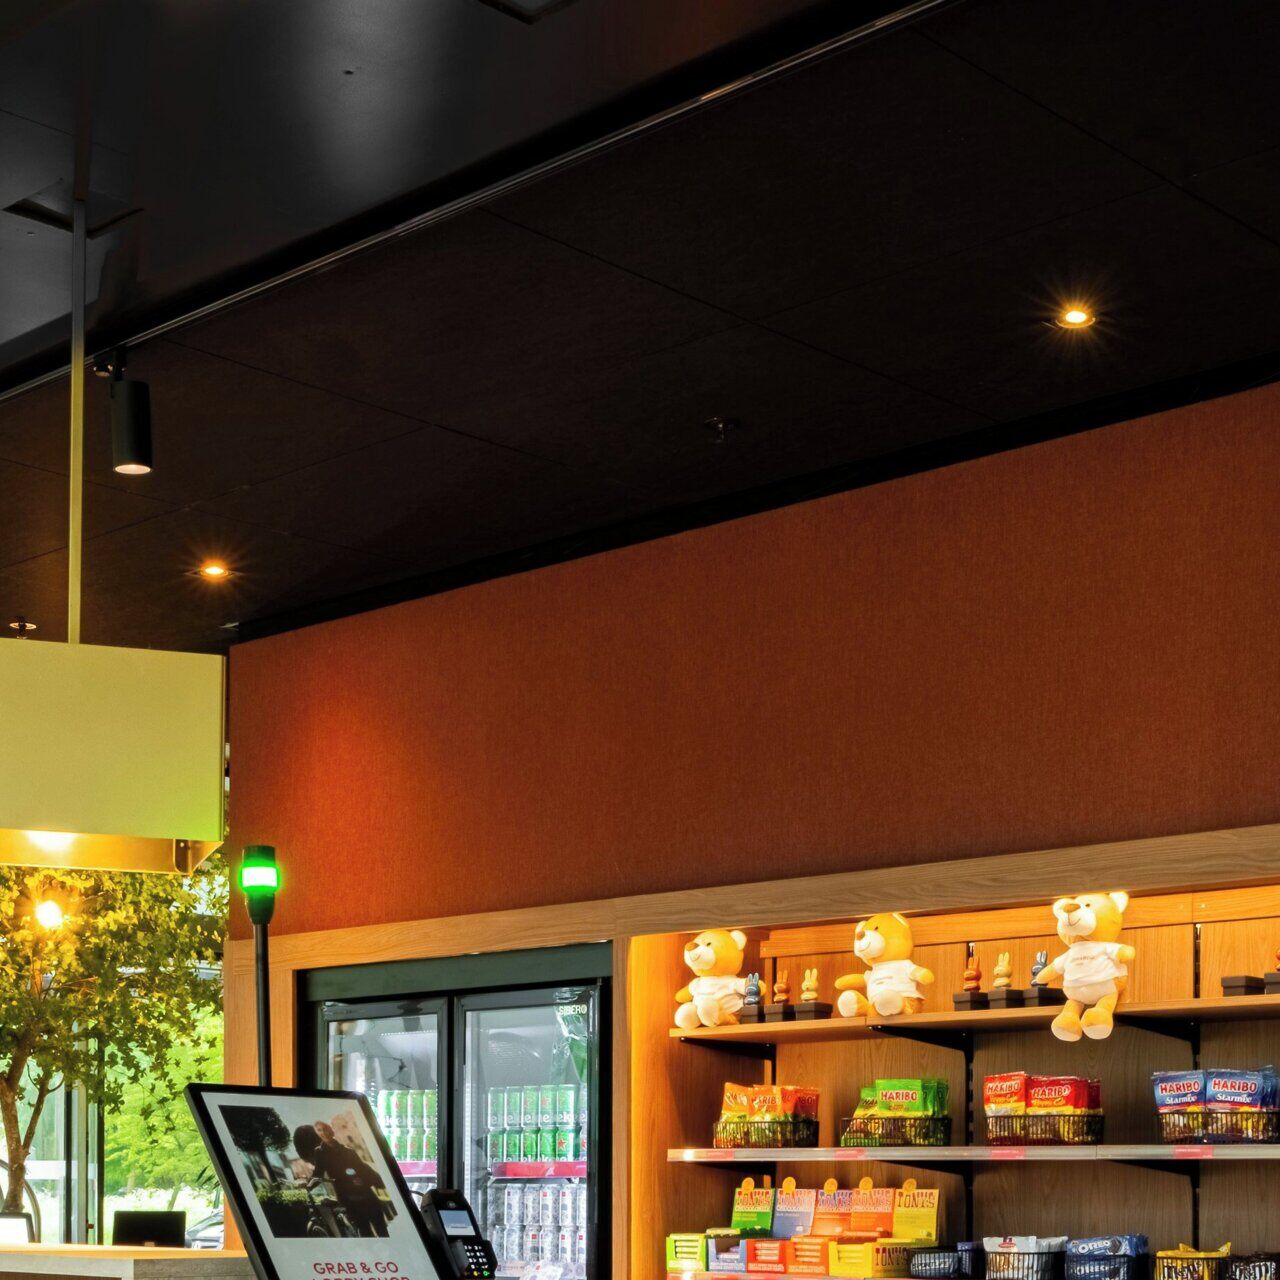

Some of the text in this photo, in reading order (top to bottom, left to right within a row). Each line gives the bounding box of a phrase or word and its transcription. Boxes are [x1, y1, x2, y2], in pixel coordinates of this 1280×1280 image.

[987, 1081, 1020, 1094] HARIBO
[1032, 1085, 1071, 1098] HARIBO
[1160, 1081, 1200, 1094] HARIBO
[1212, 1079, 1258, 1093] HARIBO
[880, 1091, 919, 1101] HARIBO
[1165, 1094, 1197, 1104] Starmix
[1216, 1093, 1252, 1103] Starmix
[1078, 1241, 1111, 1255] OREO
[313, 1261, 399, 1275] GRAB & GO
